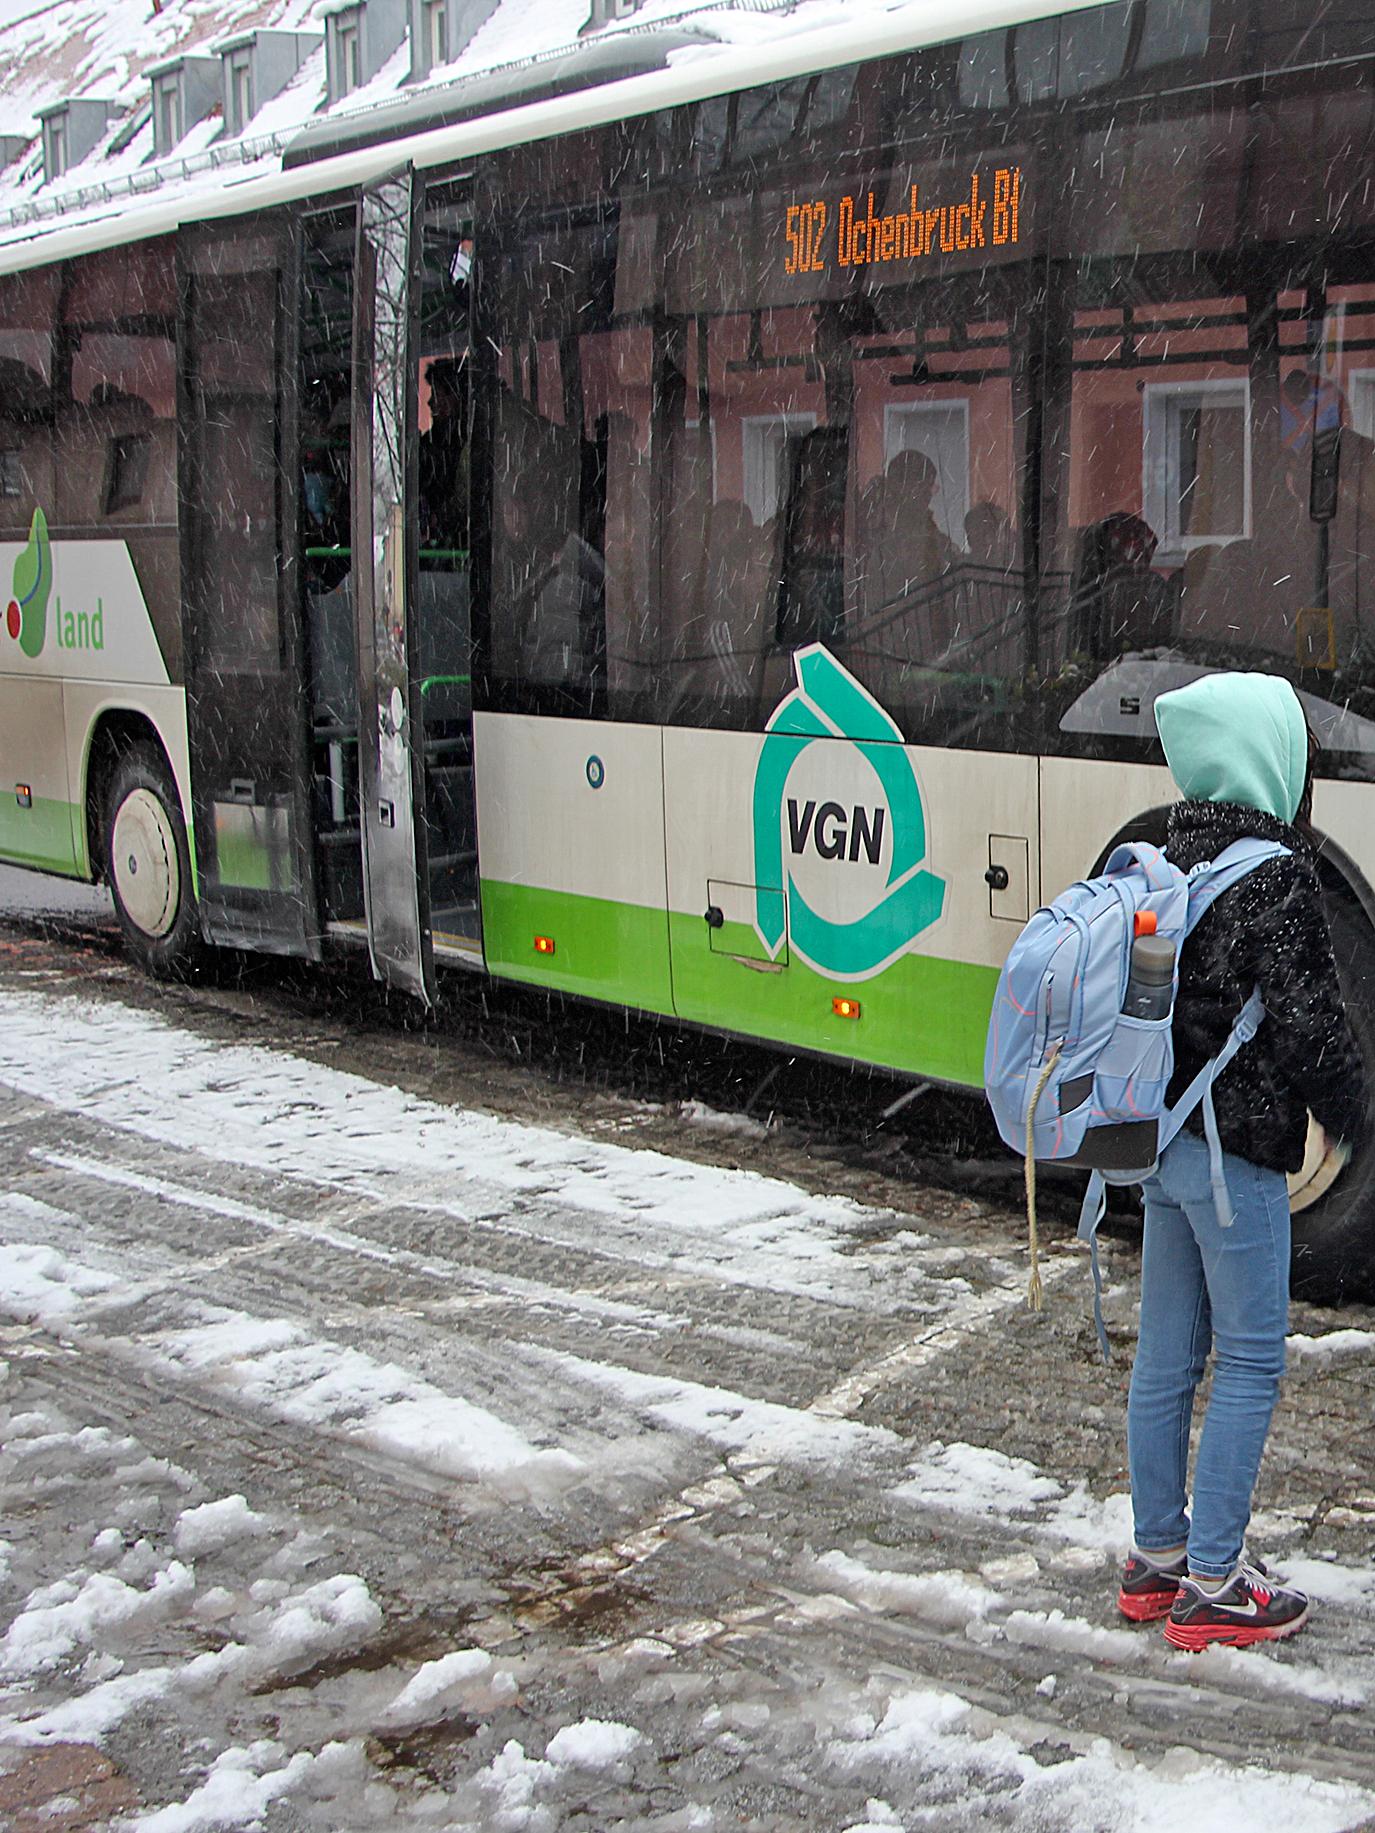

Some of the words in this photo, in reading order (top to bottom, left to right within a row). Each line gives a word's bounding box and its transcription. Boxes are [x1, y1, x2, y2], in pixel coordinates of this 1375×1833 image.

[784, 200, 827, 275] 502
[838, 174, 986, 267] Ochenbruck
[56, 596, 105, 650] land
[787, 798, 885, 865] VGN
